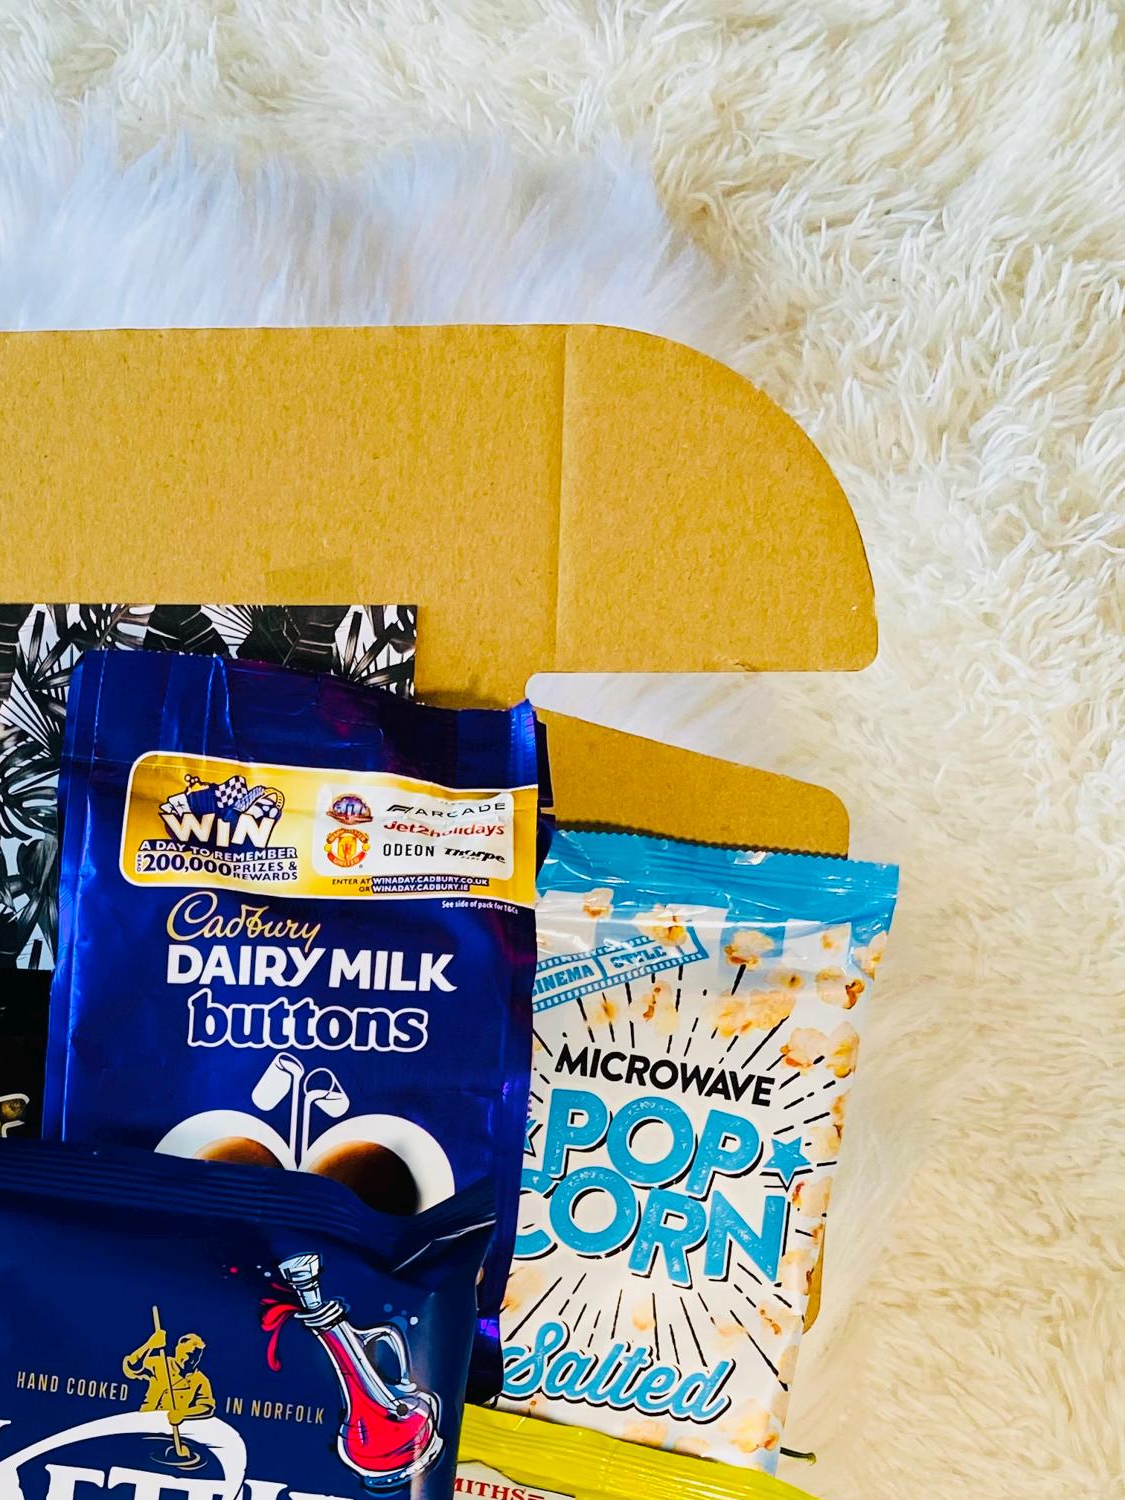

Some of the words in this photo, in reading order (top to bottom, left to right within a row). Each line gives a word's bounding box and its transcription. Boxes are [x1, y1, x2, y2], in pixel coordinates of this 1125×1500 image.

[415, 802, 506, 818] ARCADE
[164, 813, 275, 848] WIN
[140, 841, 151, 851] A
[156, 841, 185, 852] DAY
[190, 845, 210, 856] TO
[215, 848, 296, 862] REMEMBER
[143, 853, 232, 876] 200,000
[234, 862, 284, 873] PRIZES
[290, 862, 298, 872] &
[383, 843, 435, 857] ODEON
[234, 871, 298, 881] REWARDS
[332, 878, 358, 886] ENTER
[360, 877, 370, 885] AT
[373, 876, 488, 886] WINADAY.CADBURY.CO.UK
[373, 883, 468, 893] WINADAY.CADBURY.IE
[442, 900, 453, 910] See
[455, 900, 469, 910] side
[470, 900, 477, 909] of
[478, 900, 493, 911] pack
[494, 903, 503, 912] for
[166, 891, 322, 952] Cadbury
[166, 944, 326, 988] DAIRY
[328, 949, 458, 992] MILK
[187, 988, 429, 1053] buttons
[555, 1043, 776, 1108] MICROWAVE
[542, 1087, 763, 1200] POP
[501, 1321, 734, 1424] Salted
[16, 1371, 59, 1394] HAND
[66, 1377, 130, 1402] COOKED
[225, 1396, 245, 1414] IN
[251, 1399, 326, 1425] NORFOLK
